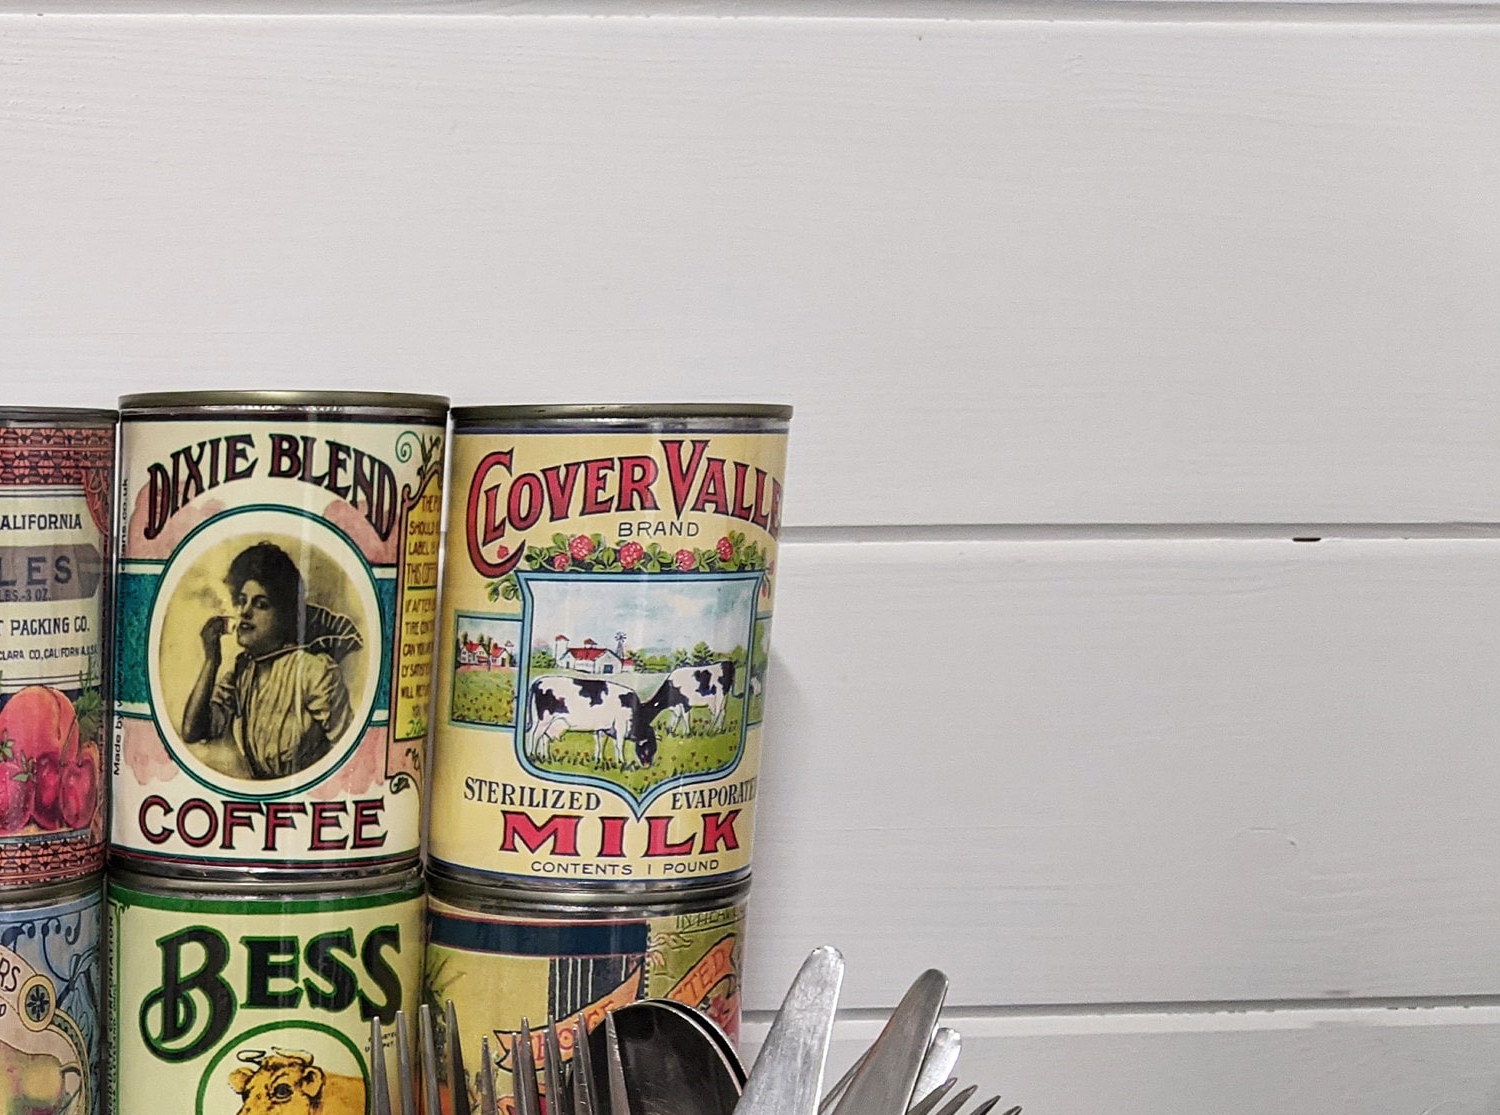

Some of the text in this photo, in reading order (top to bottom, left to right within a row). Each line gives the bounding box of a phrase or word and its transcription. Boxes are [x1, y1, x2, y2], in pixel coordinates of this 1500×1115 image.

[143, 432, 398, 542] DIXIE BLEND
[466, 439, 783, 578] CLOVER VALLE
[617, 520, 700, 538] BRAND
[10, 617, 70, 636] PACKING
[74, 615, 91, 632] CO.
[463, 776, 601, 812] STERILIZED
[138, 794, 389, 853] COFFEE
[499, 809, 742, 859] MILK
[530, 859, 633, 877] CONTENTS
[663, 859, 720, 875] POUND
[139, 923, 402, 1065] BESS
